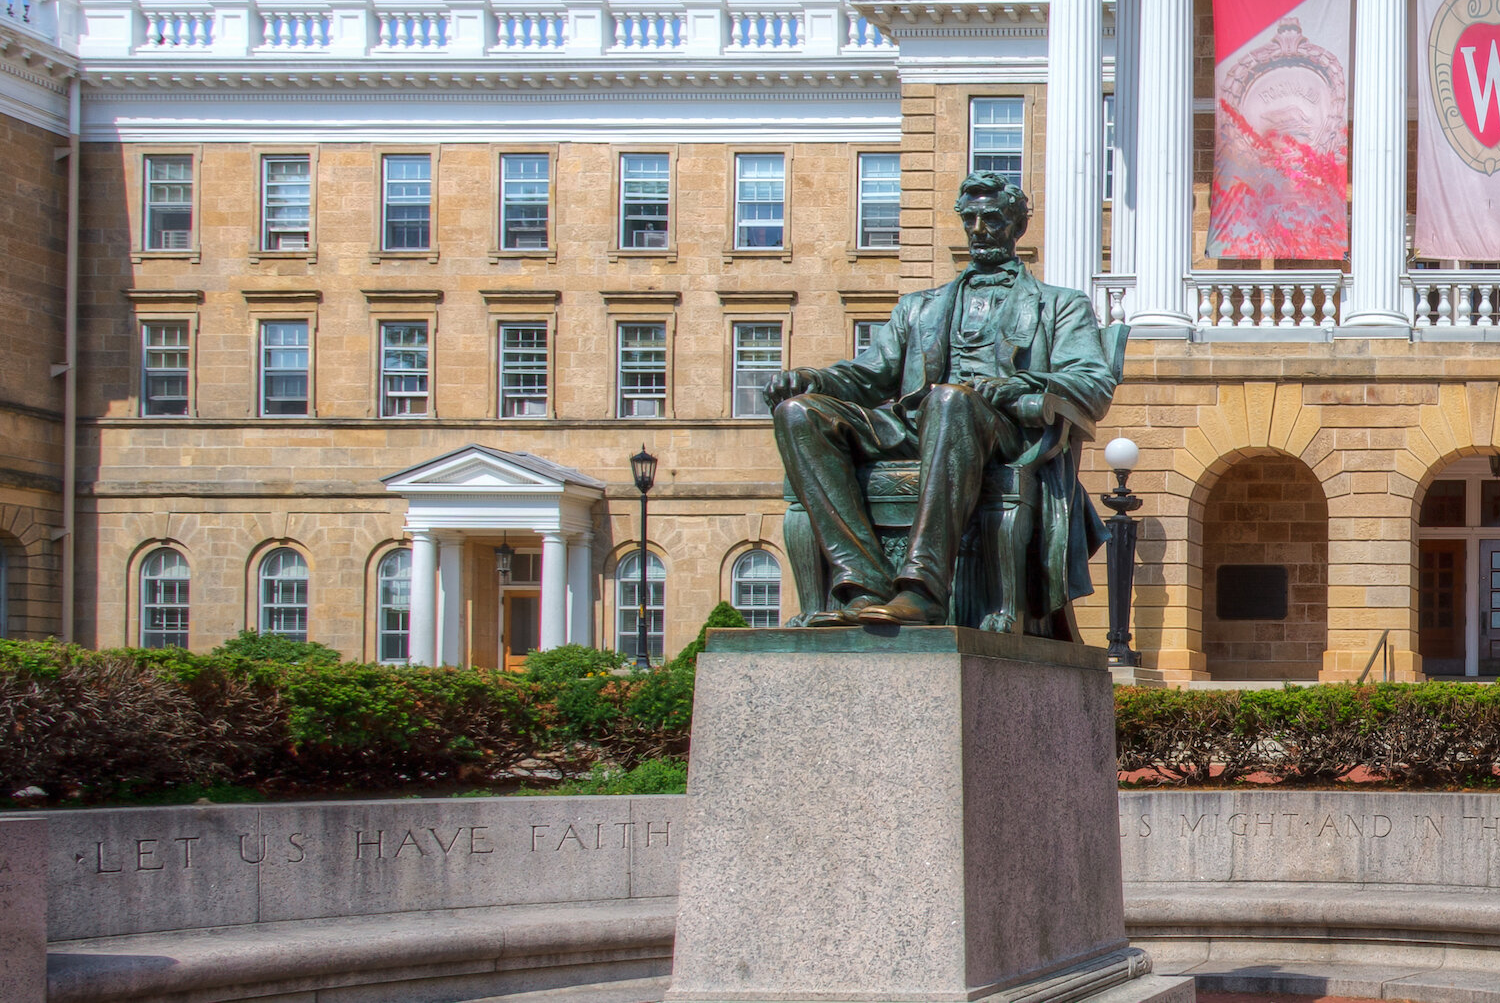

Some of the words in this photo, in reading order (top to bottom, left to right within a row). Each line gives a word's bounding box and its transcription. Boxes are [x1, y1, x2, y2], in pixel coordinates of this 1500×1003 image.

[96, 836, 201, 875] LET
[239, 832, 305, 864] US
[354, 825, 495, 860] HAVE
[529, 820, 672, 853] FAITH
[1180, 813, 1299, 839] MIGHT
[1316, 813, 1393, 839] AND
[1412, 814, 1445, 841] IN
